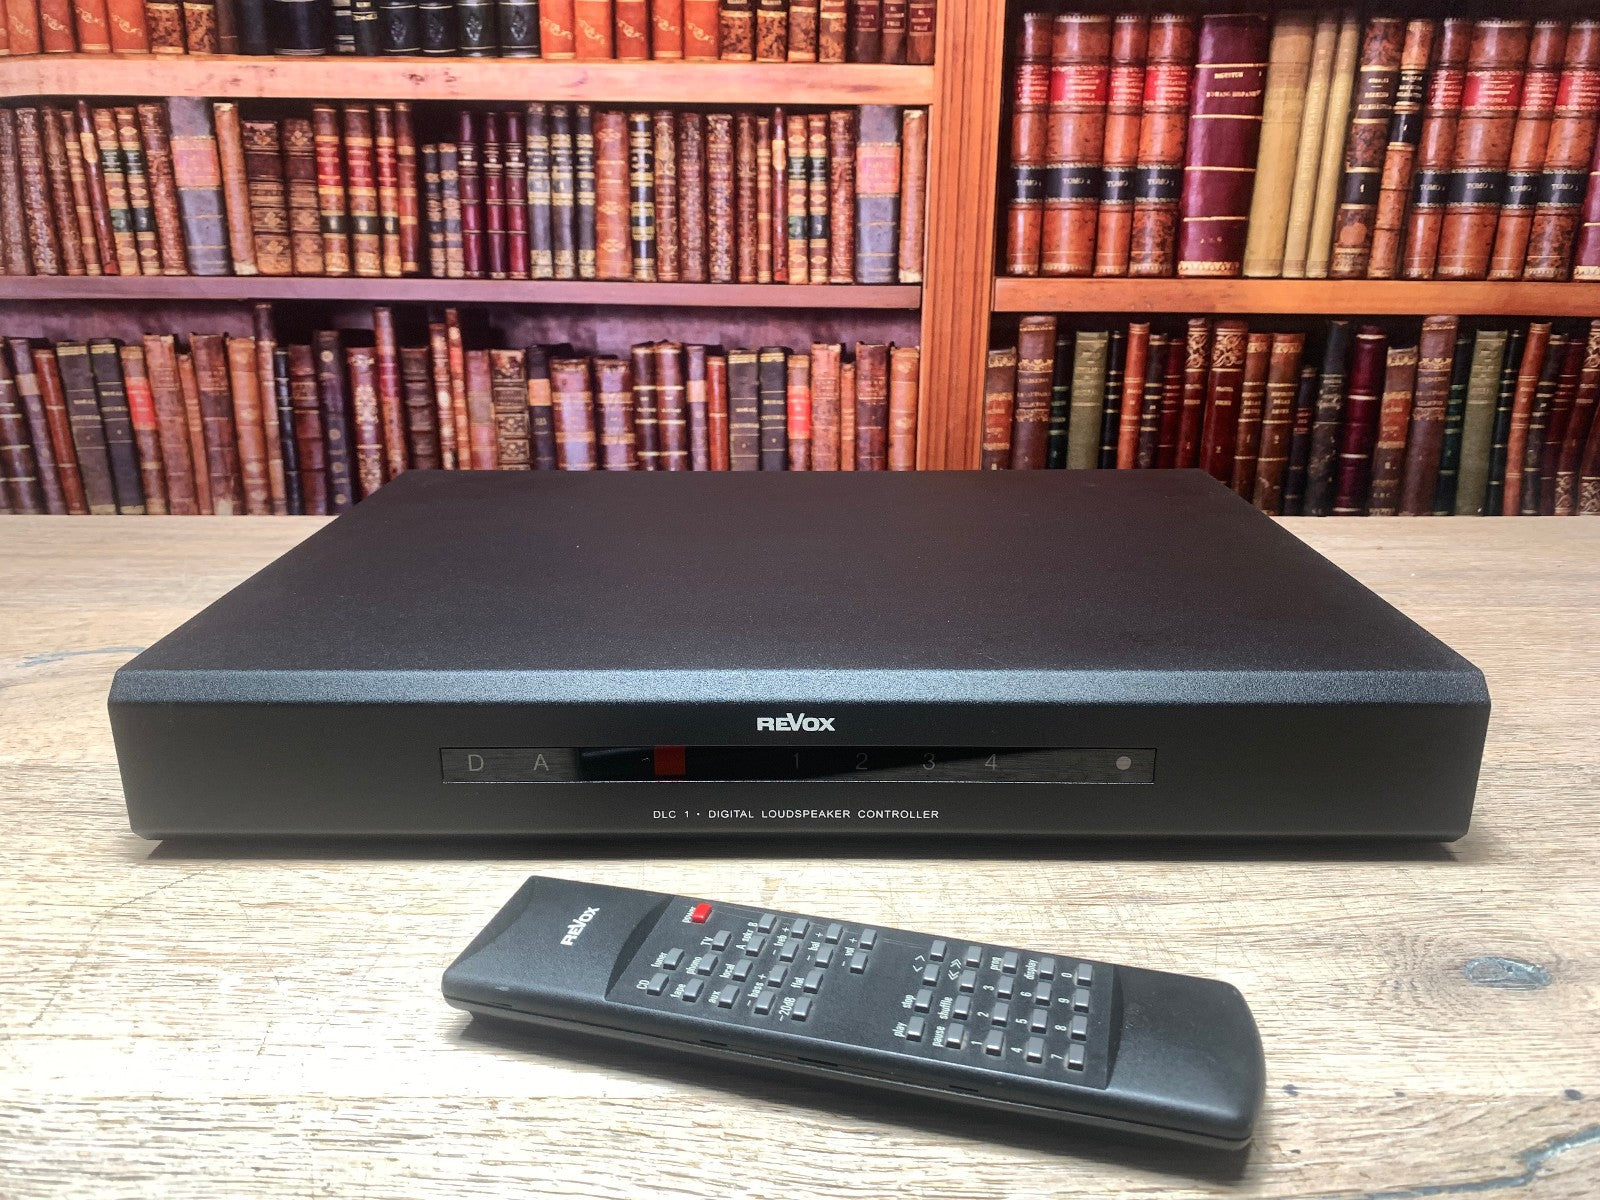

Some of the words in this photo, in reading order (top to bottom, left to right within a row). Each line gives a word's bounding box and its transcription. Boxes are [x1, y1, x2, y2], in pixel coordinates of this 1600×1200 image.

[1062, 177, 1085, 185] TOMO
[1466, 182, 1489, 190] TOMO
[468, 754, 484, 772] D
[533, 753, 549, 771] A
[793, 752, 800, 769] 1
[855, 752, 869, 770] 2
[922, 752, 936, 771] 3
[984, 753, 998, 771] 4
[653, 810, 677, 819] DLC
[684, 810, 690, 818] 1
[708, 809, 755, 819] DIGITAL
[761, 809, 851, 819] LOUDSPEAKER
[857, 809, 940, 819] CONTROLLER
[700, 936, 714, 946] TV
[807, 941, 821, 951] bal
[844, 946, 856, 956] vol
[650, 952, 668, 968] tuner
[685, 956, 703, 975] phono
[990, 956, 1002, 971] prog
[719, 963, 736, 979] local
[1024, 959, 1038, 980] display
[636, 979, 650, 990] CD
[747, 981, 765, 998] bass
[790, 976, 805, 989] flat
[669, 983, 687, 998] tape
[708, 990, 722, 1004] aux
[902, 994, 917, 1009] stop
[938, 996, 953, 1020] shuffle
[892, 1021, 908, 1038] play
[932, 1025, 946, 1048] pause
